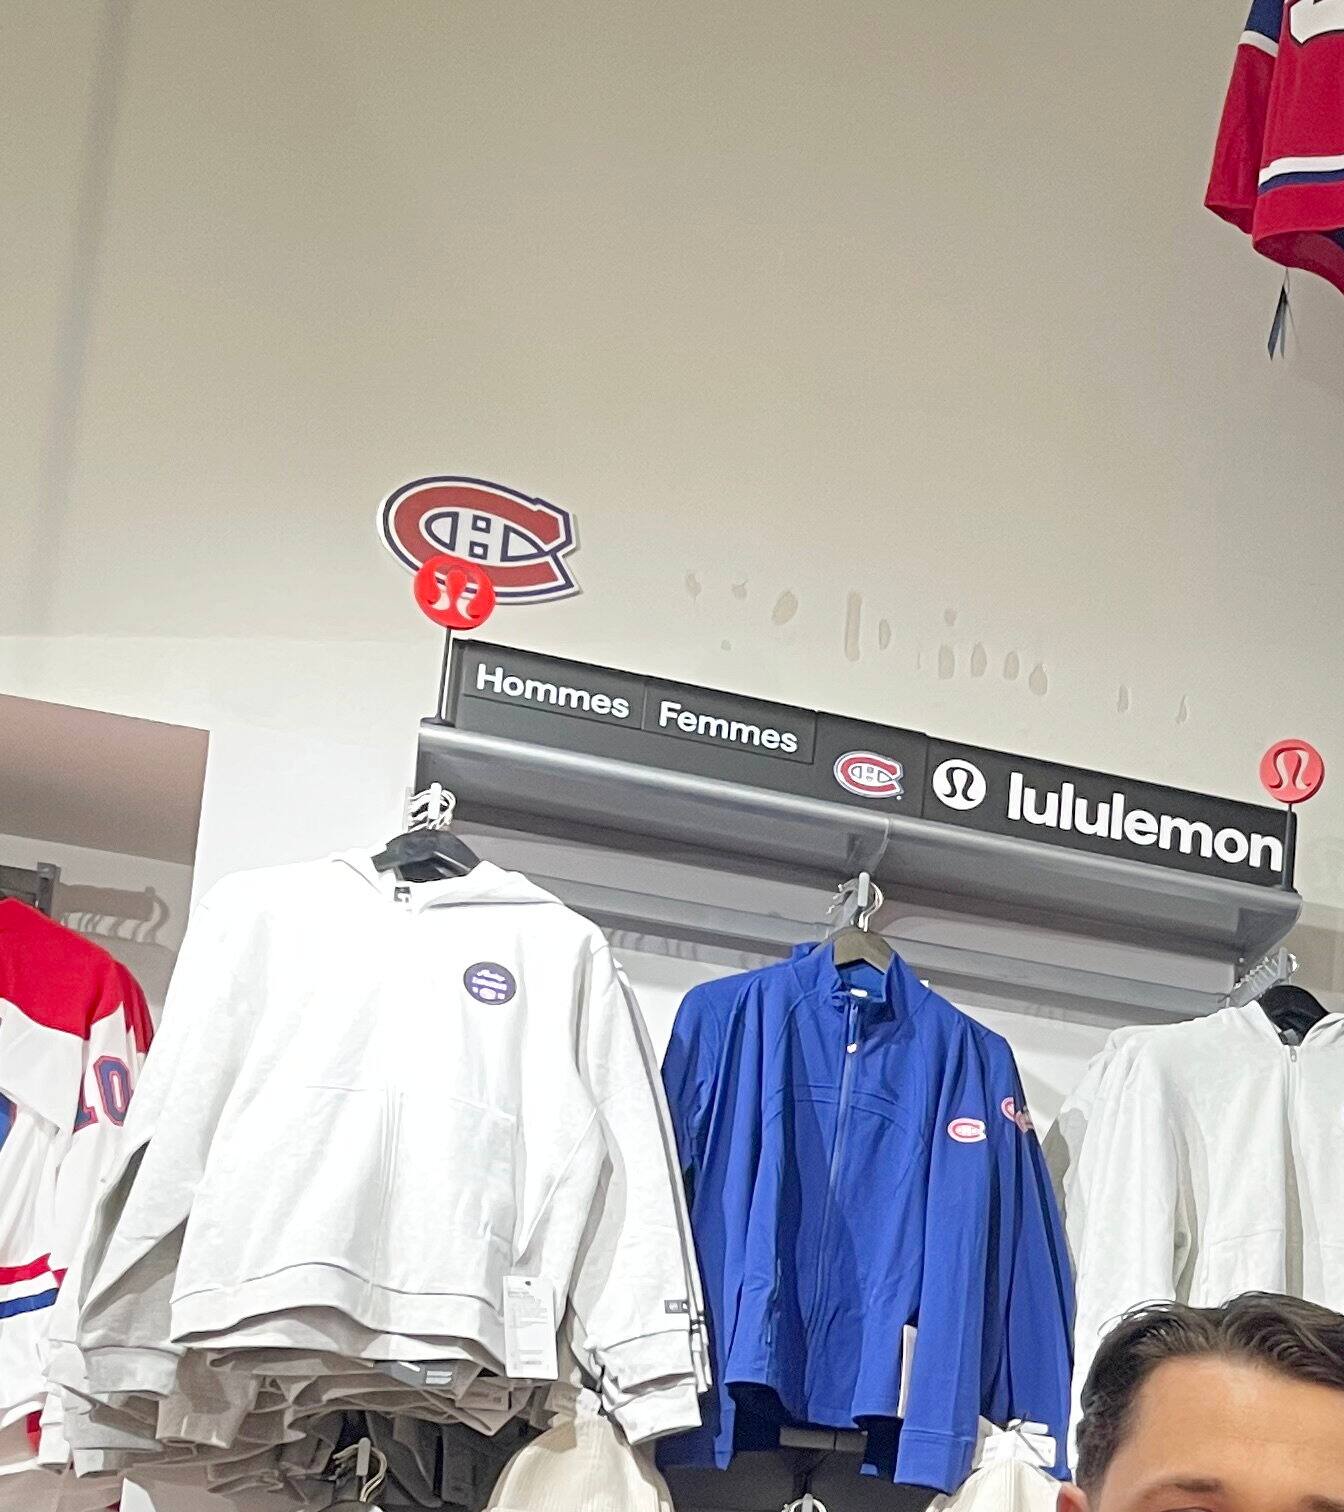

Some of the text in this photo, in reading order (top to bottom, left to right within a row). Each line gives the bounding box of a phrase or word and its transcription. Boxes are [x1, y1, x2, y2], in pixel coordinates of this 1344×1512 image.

[475, 663, 630, 720] Hommes
[658, 701, 799, 754] Femmes
[1008, 771, 1284, 873] lululemon
